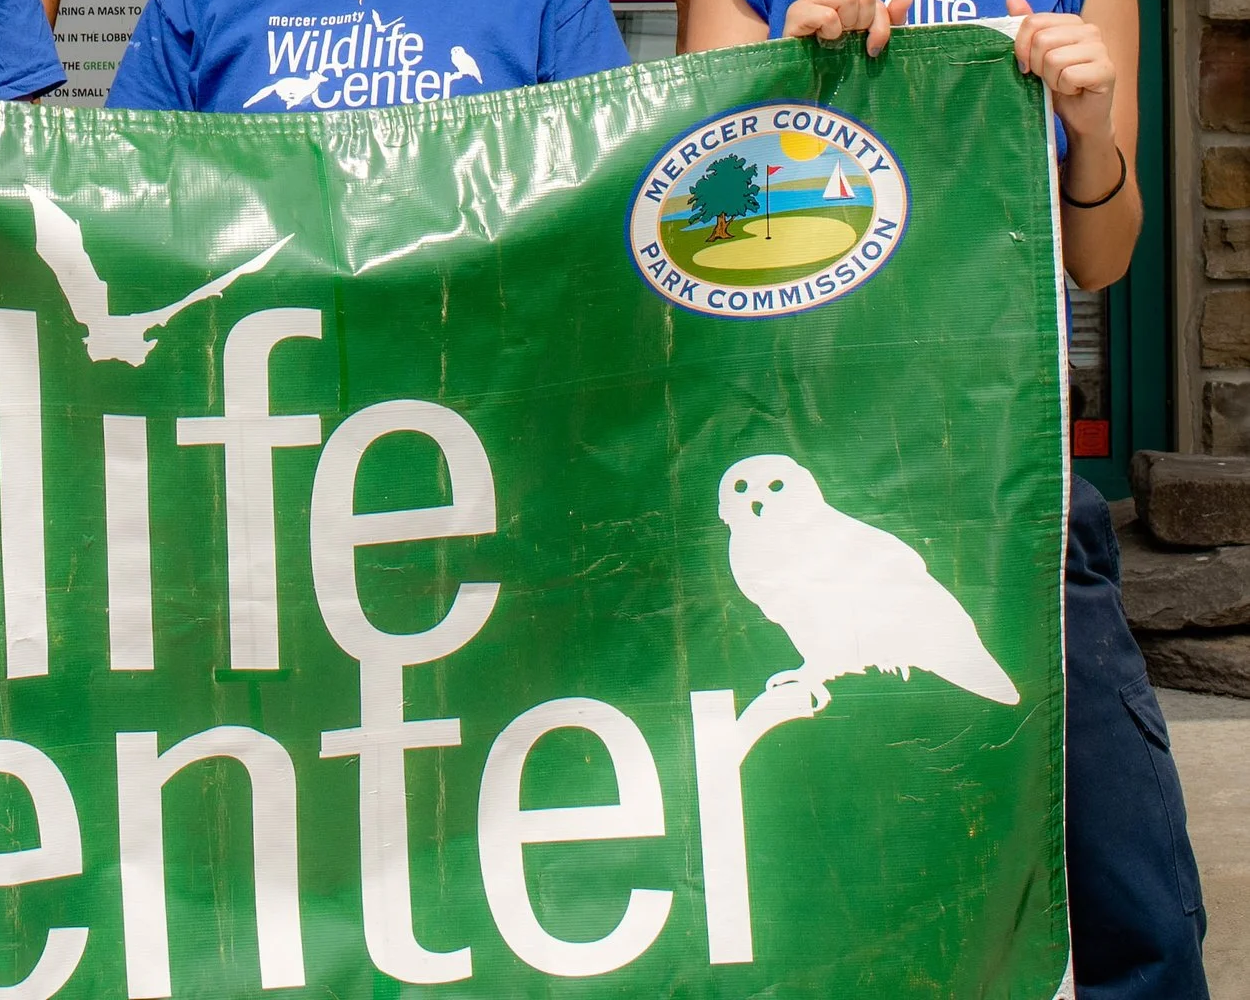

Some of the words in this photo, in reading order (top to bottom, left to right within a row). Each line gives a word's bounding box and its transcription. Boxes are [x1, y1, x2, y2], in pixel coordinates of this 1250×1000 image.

[87, 6, 95, 16] A
[98, 6, 126, 16] MASK
[128, 6, 142, 16] TO
[268, 15, 317, 27] mercer
[320, 11, 365, 28] county
[68, 33, 78, 42] IN
[80, 33, 99, 42] THE
[267, 23, 424, 75] Wildlife
[62, 61, 80, 71] THE
[83, 61, 115, 71] GREEN
[54, 88, 69, 98] ON
[72, 88, 104, 98] SMALL
[312, 66, 456, 109] Center
[644, 115, 759, 203] MERCER
[772, 110, 890, 175] COUNTY
[640, 241, 700, 302] PARK
[707, 217, 898, 311] COMMISSION
